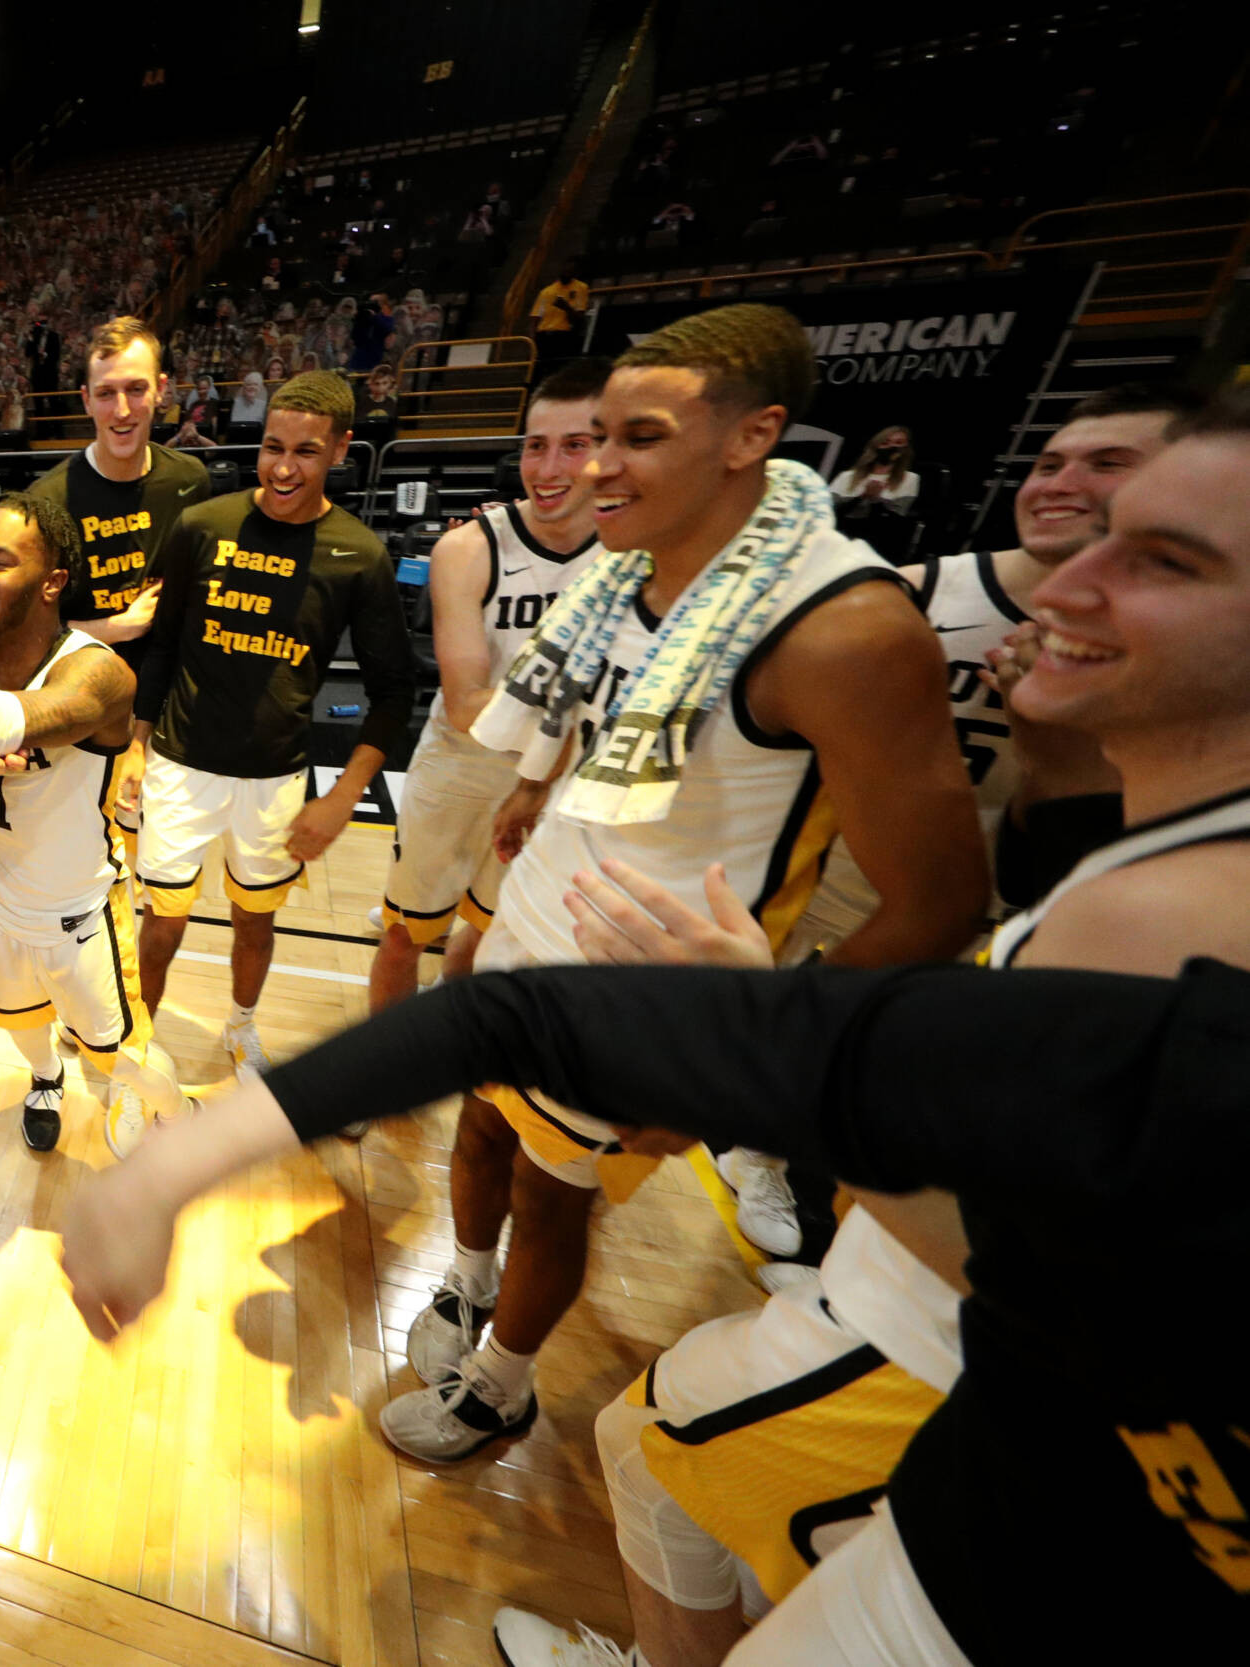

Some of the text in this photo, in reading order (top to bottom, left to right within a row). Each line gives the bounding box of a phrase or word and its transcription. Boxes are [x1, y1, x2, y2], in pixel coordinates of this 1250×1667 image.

[82, 510, 152, 543] Peace
[87, 550, 146, 579] Love
[214, 539, 297, 578] Peace
[207, 580, 273, 616] Love
[202, 619, 311, 667] Equality
